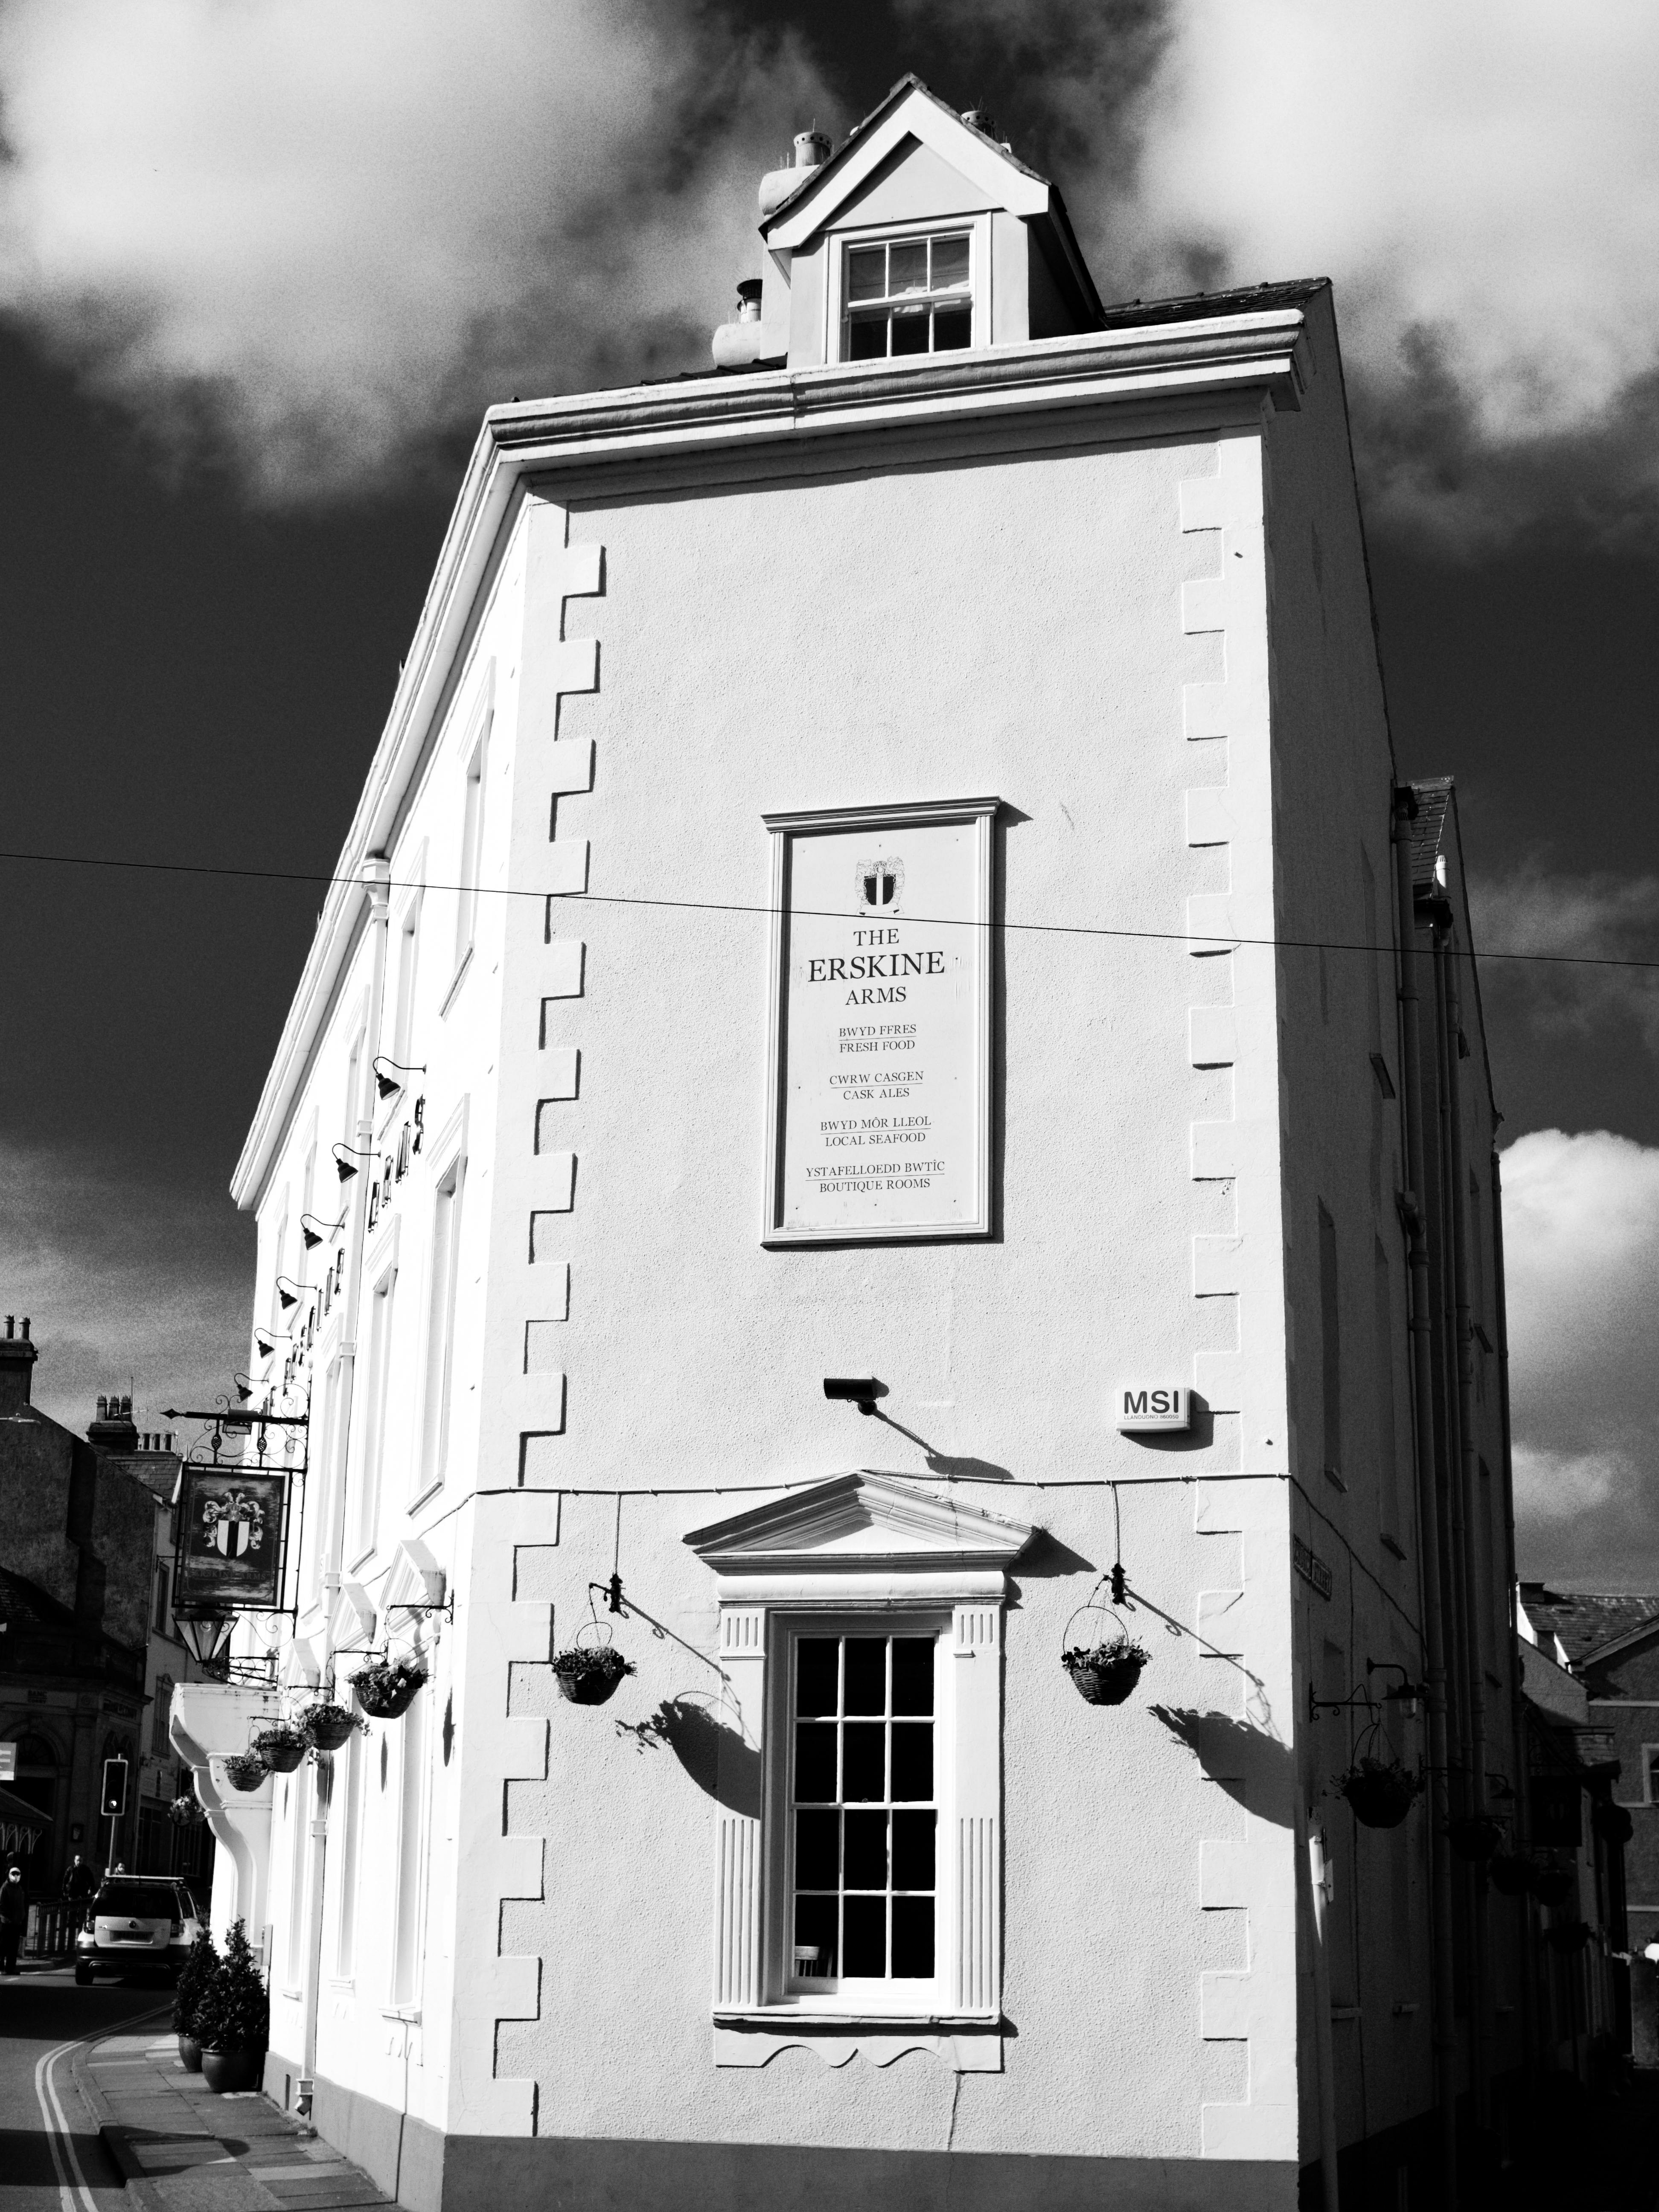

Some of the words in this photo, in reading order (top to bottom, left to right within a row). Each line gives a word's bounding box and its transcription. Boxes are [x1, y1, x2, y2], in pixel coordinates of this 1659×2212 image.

[853, 928, 899, 946] THE
[807, 951, 945, 982] ERSKINE
[845, 986, 906, 1005] ARMS
[839, 1026, 876, 1037] BWYD
[879, 1024, 917, 1034] FFRES
[839, 1042, 878, 1053] FRESH
[882, 1040, 915, 1051] FOOD
[830, 1074, 870, 1085] CWRW
[874, 1071, 924, 1083] CASGEN
[843, 1089, 874, 1100] CASK
[879, 1088, 910, 1098] ALES
[821, 1120, 857, 1131] BWYD
[861, 1117, 888, 1129] MÔR
[893, 1116, 931, 1127] LLEOL
[825, 1135, 865, 1147] LOCAL
[869, 1132, 926, 1144] SEAFOOD
[806, 1164, 901, 1177] YSTAFELLOEDD
[905, 1159, 945, 1173] BWTÎC
[820, 1181, 883, 1193] BOUTIQUE
[886, 1178, 930, 1190] ROOMS
[1124, 1390, 1179, 1414] MSI
